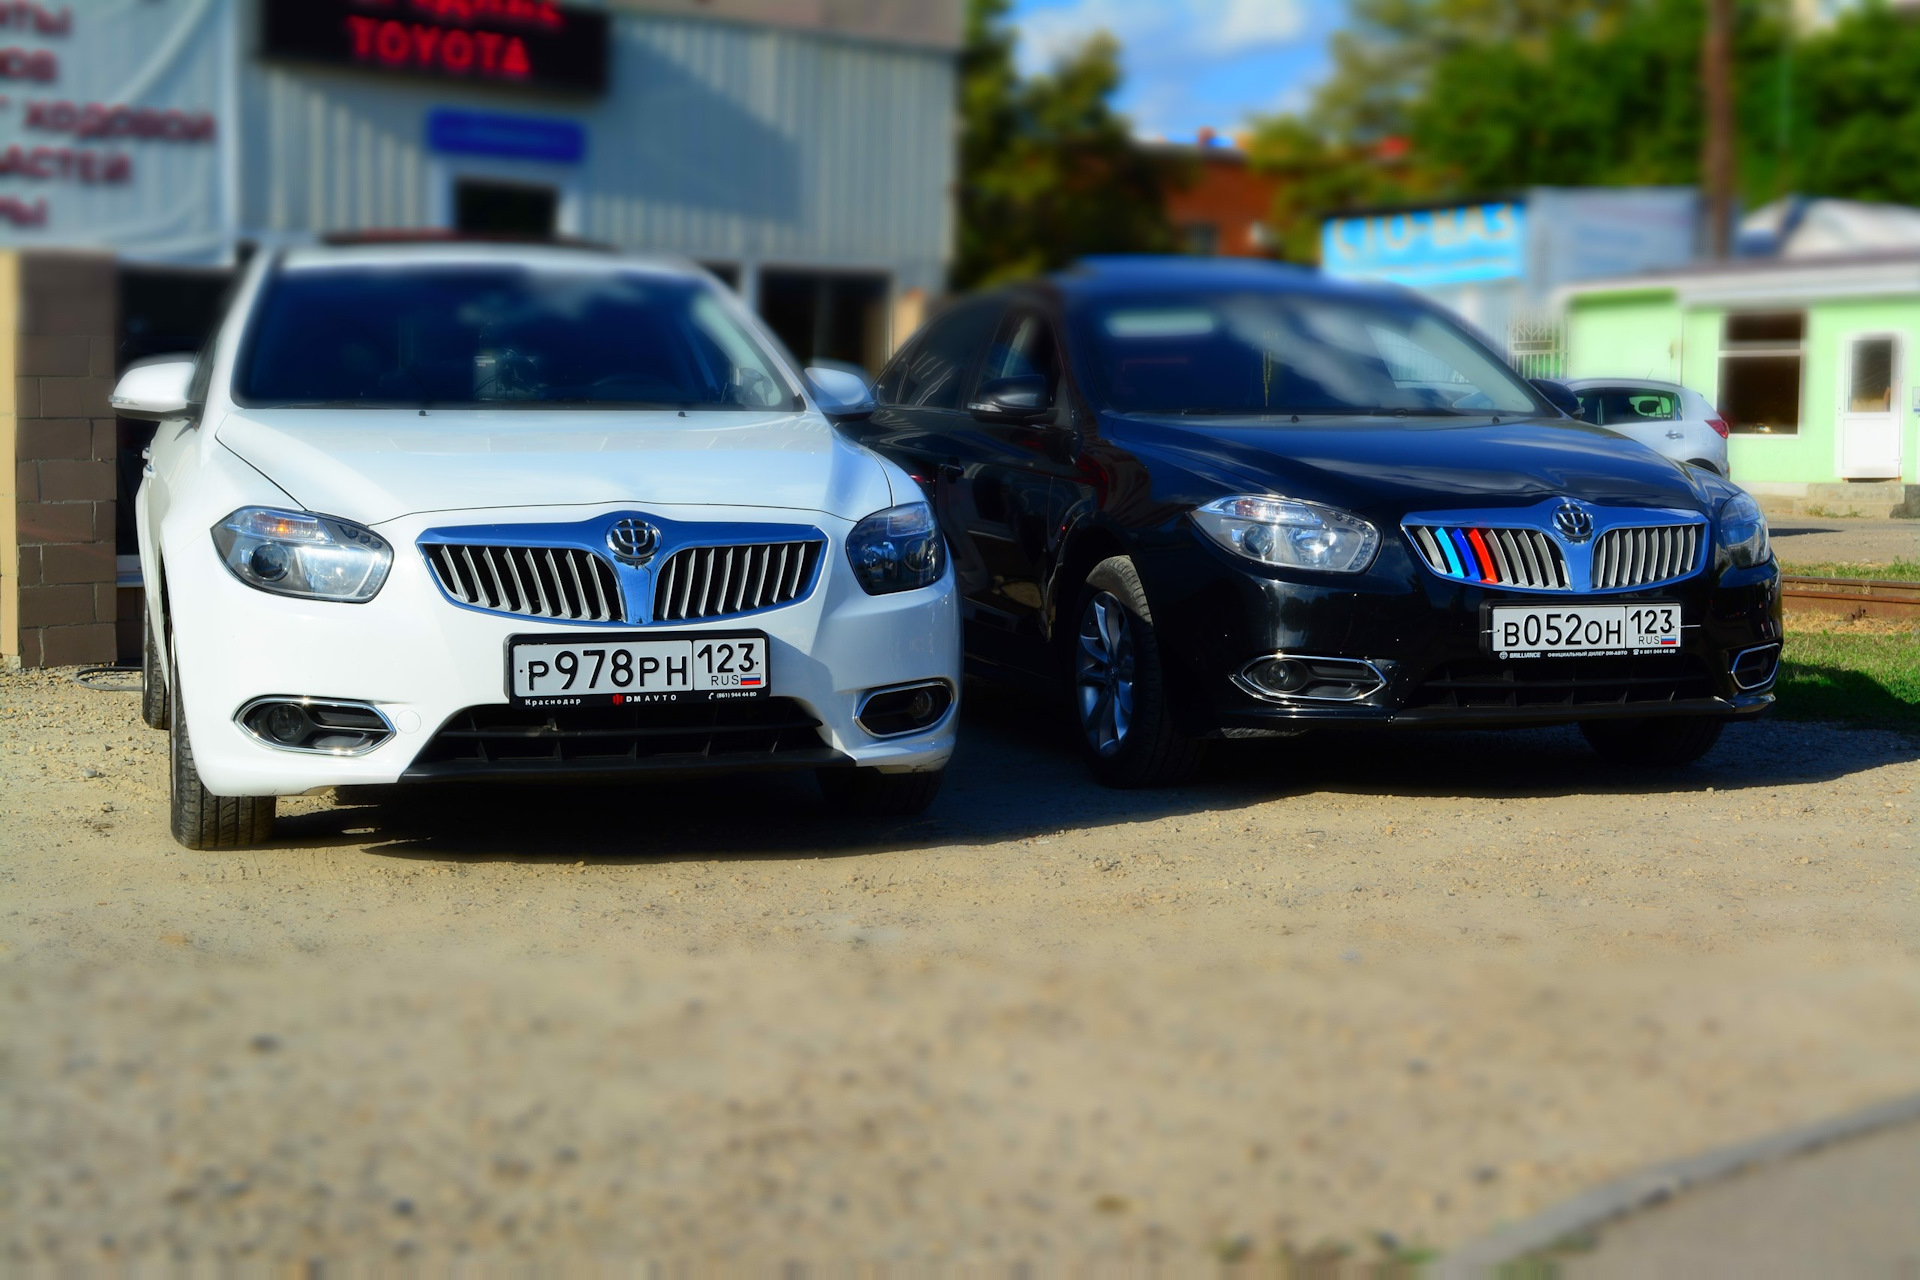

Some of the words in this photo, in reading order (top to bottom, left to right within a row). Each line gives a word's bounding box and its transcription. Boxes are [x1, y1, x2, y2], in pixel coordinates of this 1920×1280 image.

[348, 14, 531, 74] TOYOTA
[1630, 609, 1673, 635] 123
[1638, 635, 1660, 645] RUS
[697, 643, 755, 674] 123
[711, 674, 739, 686] RUS
[524, 698, 582, 707] Краснодар
